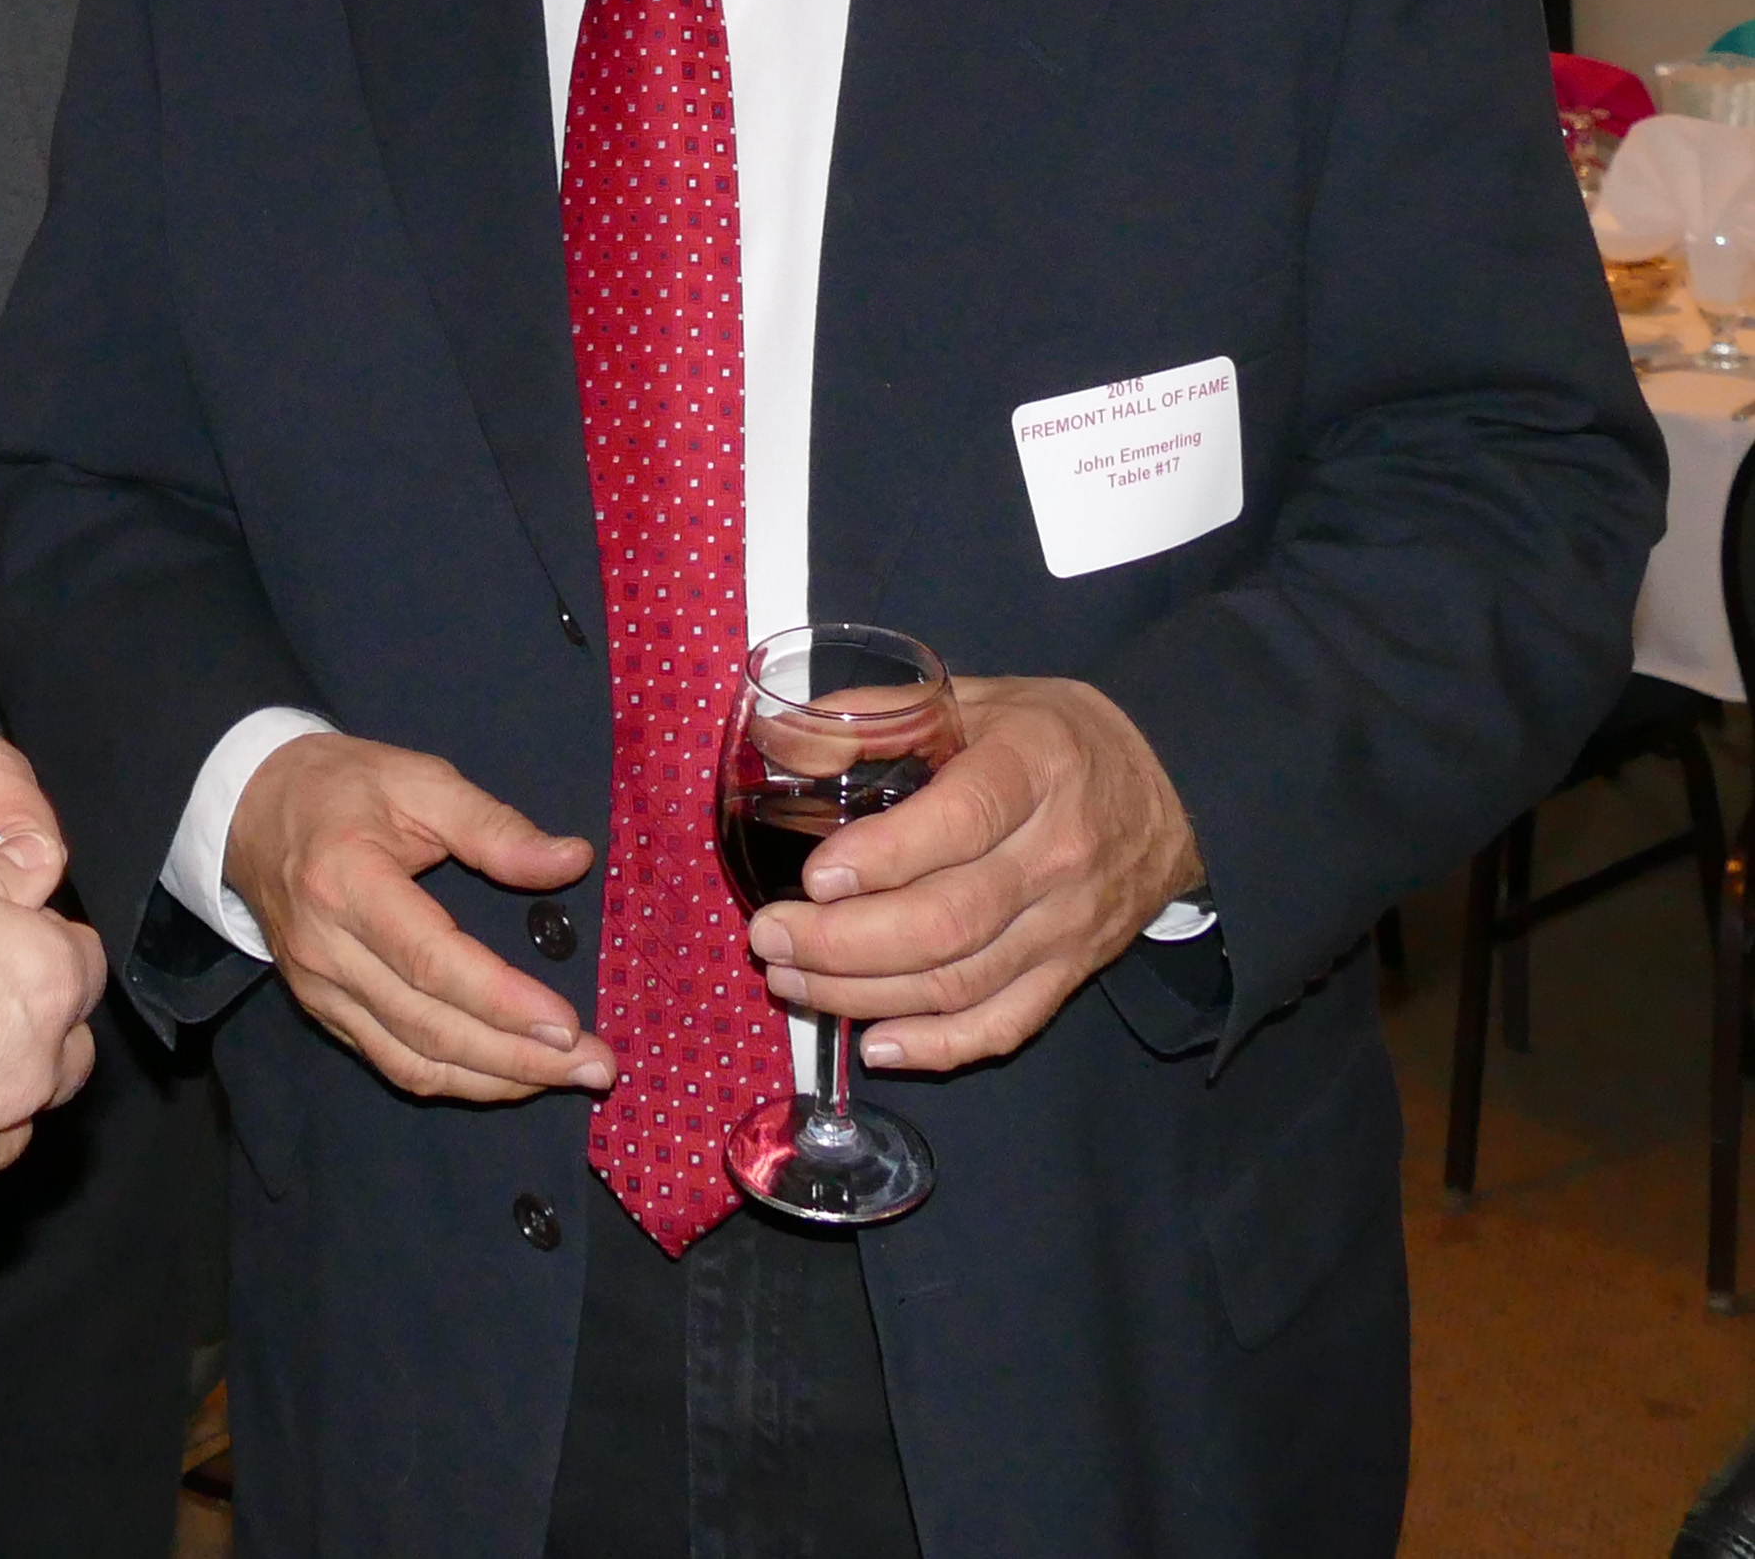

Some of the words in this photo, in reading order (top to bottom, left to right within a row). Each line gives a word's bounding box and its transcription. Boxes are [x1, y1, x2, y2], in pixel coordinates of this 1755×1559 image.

[1107, 376, 1144, 399] 2016
[1020, 408, 1107, 442] FREMONT
[1112, 397, 1156, 420] HALL
[1161, 389, 1184, 408] OF
[1188, 375, 1230, 401] FAME
[1074, 455, 1115, 475] John
[1120, 431, 1202, 465] Emmerling
[1107, 467, 1151, 489] Table
[1155, 456, 1180, 477] #17
